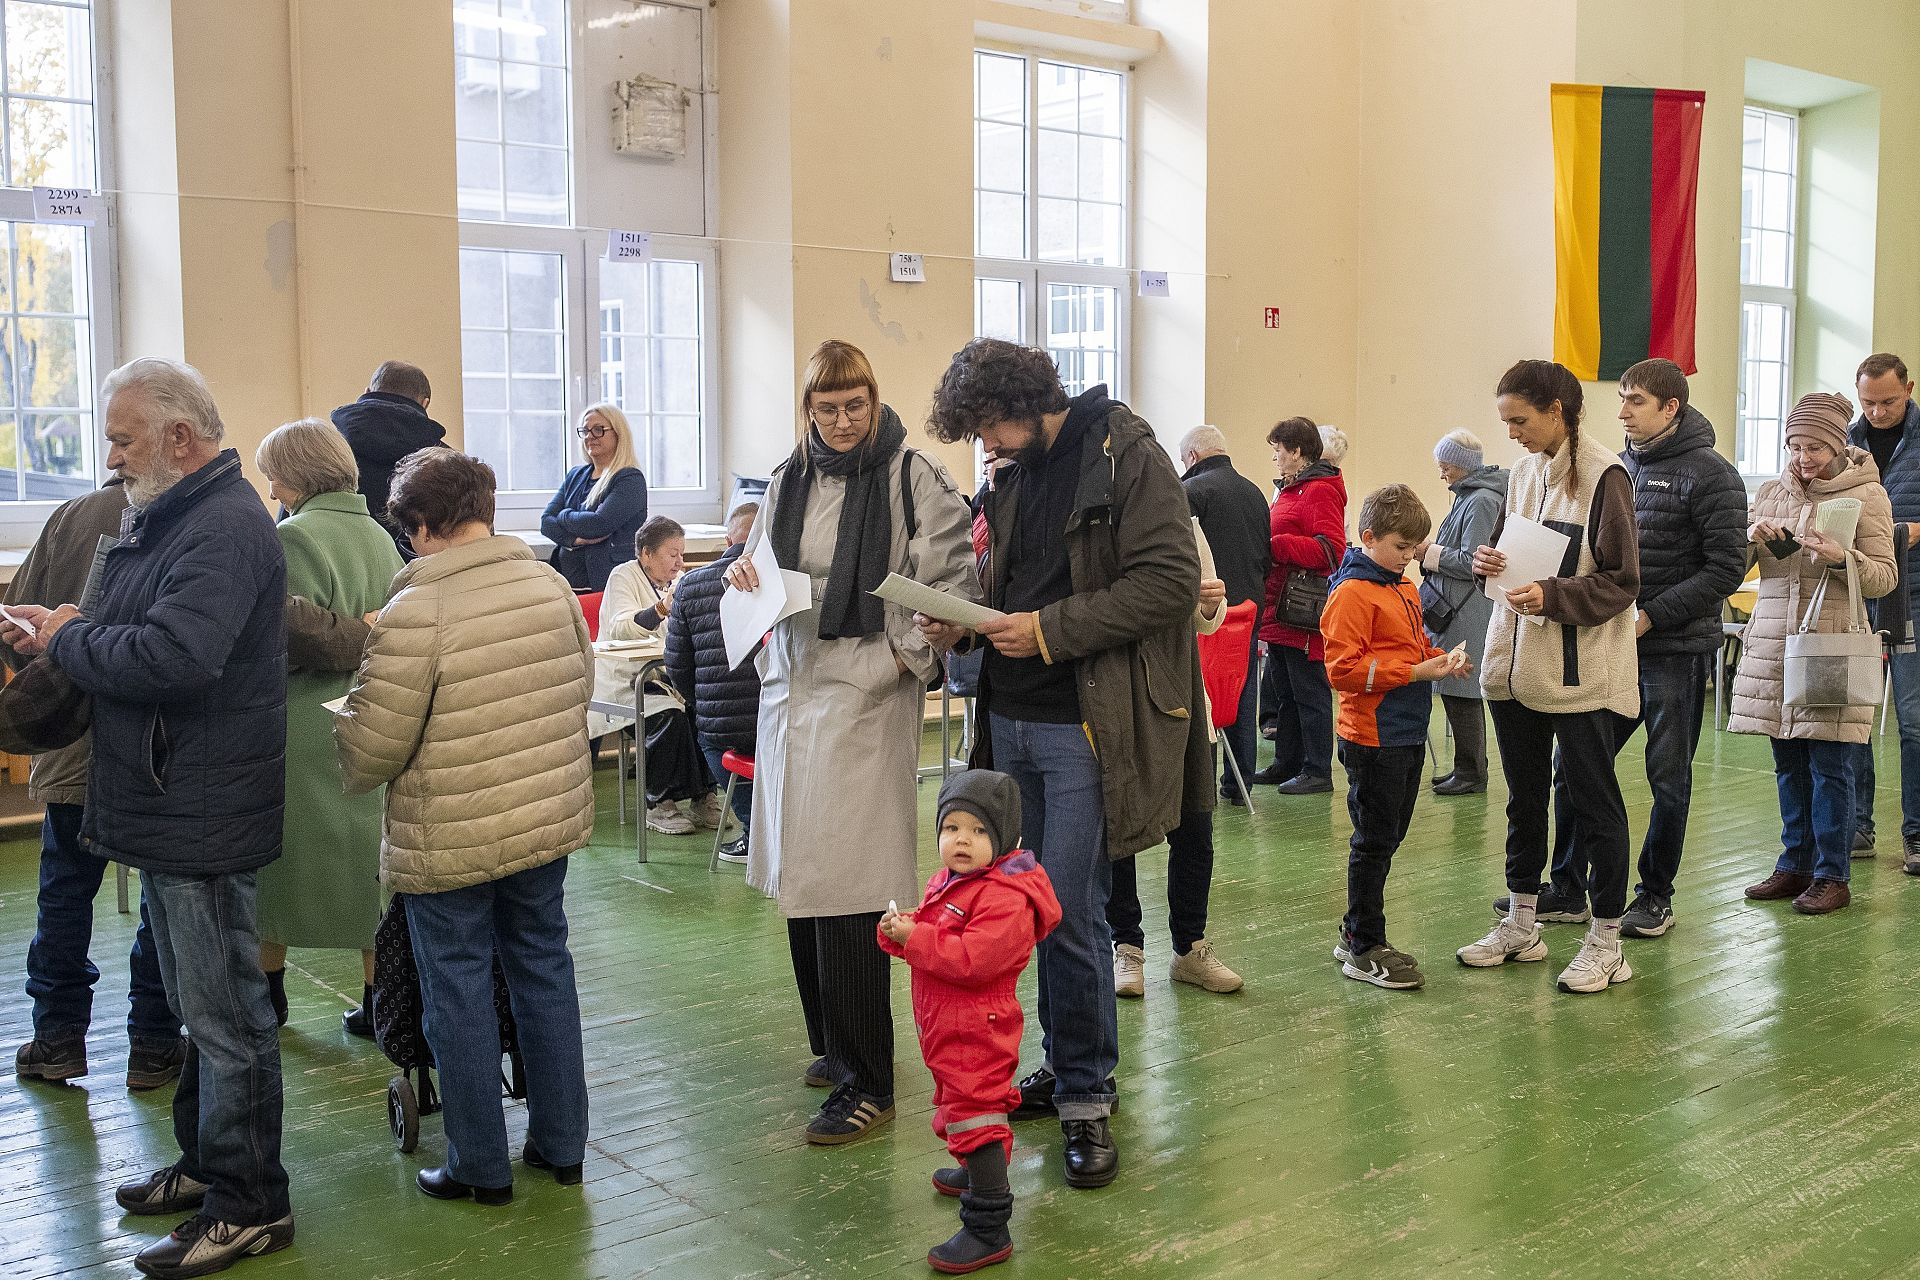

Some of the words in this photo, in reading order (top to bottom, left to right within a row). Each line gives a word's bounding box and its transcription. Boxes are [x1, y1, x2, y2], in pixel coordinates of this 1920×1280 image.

[47, 189, 79, 200] 2299
[50, 204, 82, 215] 2874
[620, 233, 640, 243] 1511
[618, 246, 641, 257] 2298
[899, 254, 912, 263] 758
[900, 267, 917, 276] 1510
[1647, 479, 1671, 488] twoday
